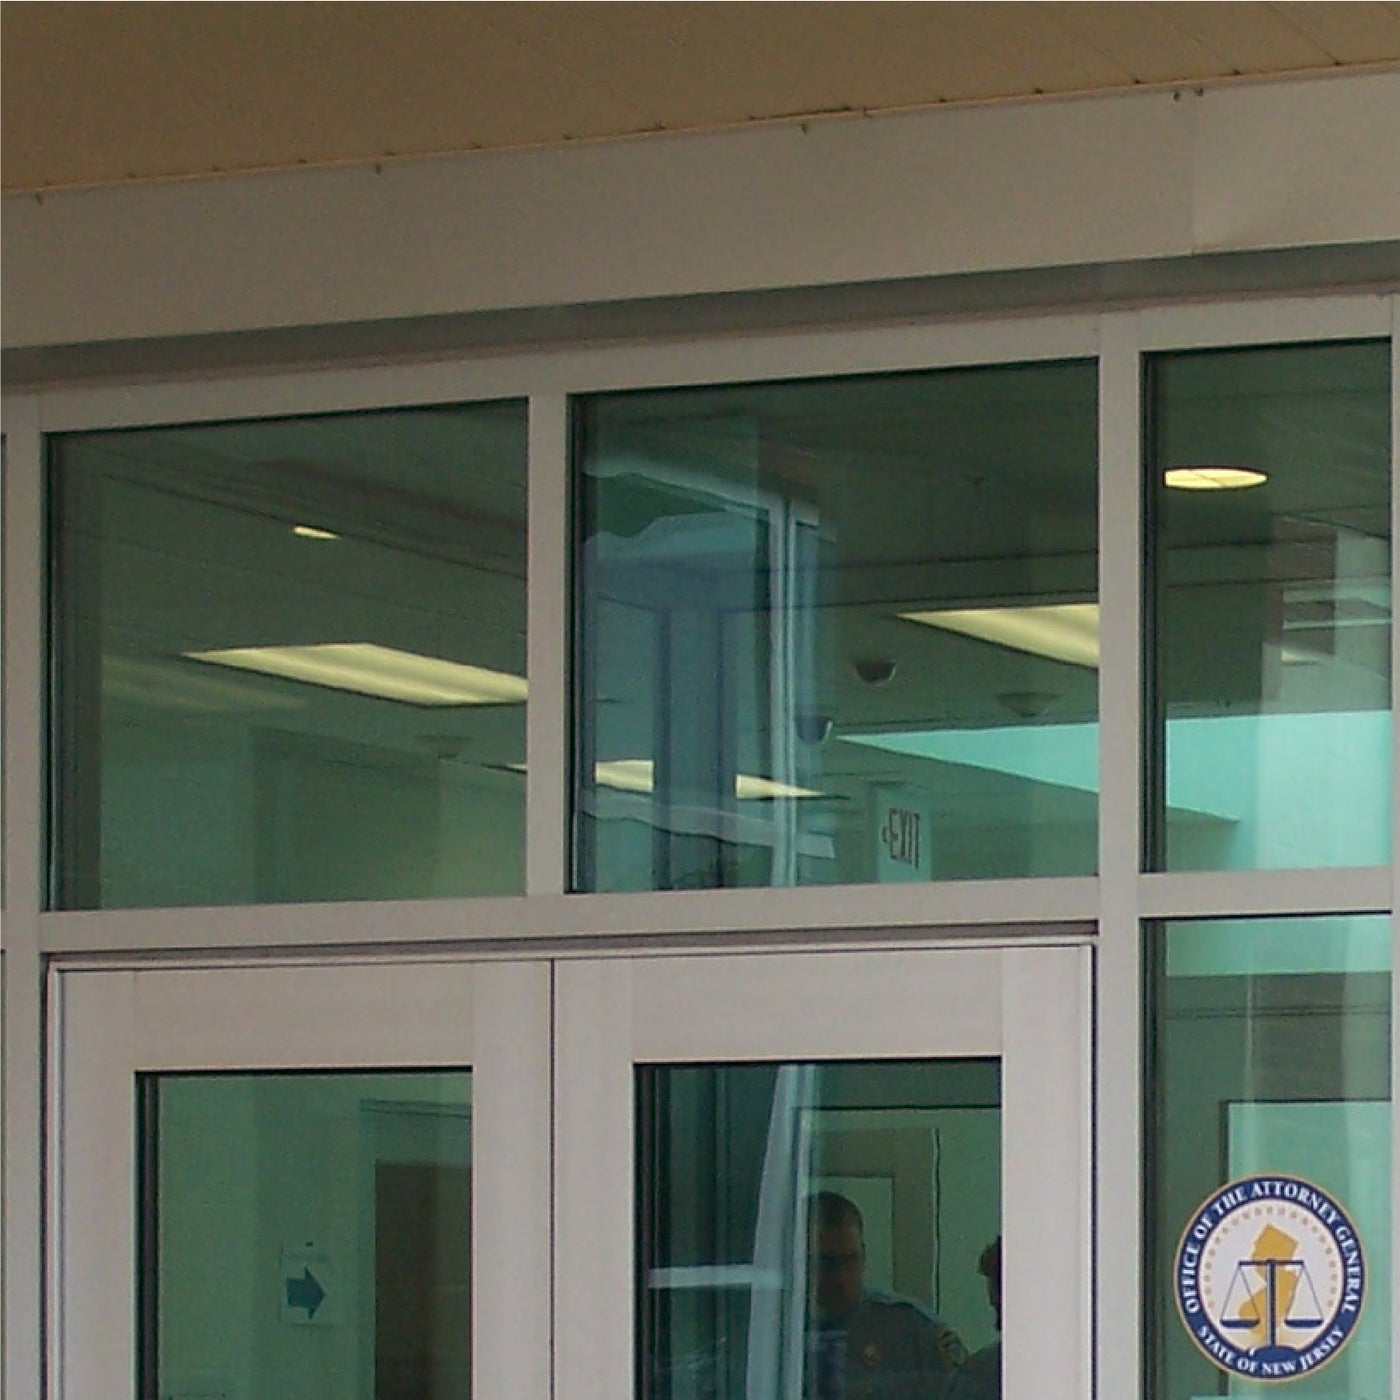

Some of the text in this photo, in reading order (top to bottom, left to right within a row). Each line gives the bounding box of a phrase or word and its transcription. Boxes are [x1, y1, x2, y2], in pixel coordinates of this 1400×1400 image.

[889, 807, 920, 869] EXIT
[1182, 1181, 1360, 1314] OFFICE OF THE ATTORNEY GENERAL
[1199, 1325, 1345, 1375] STATE OF NEW JERSEY
